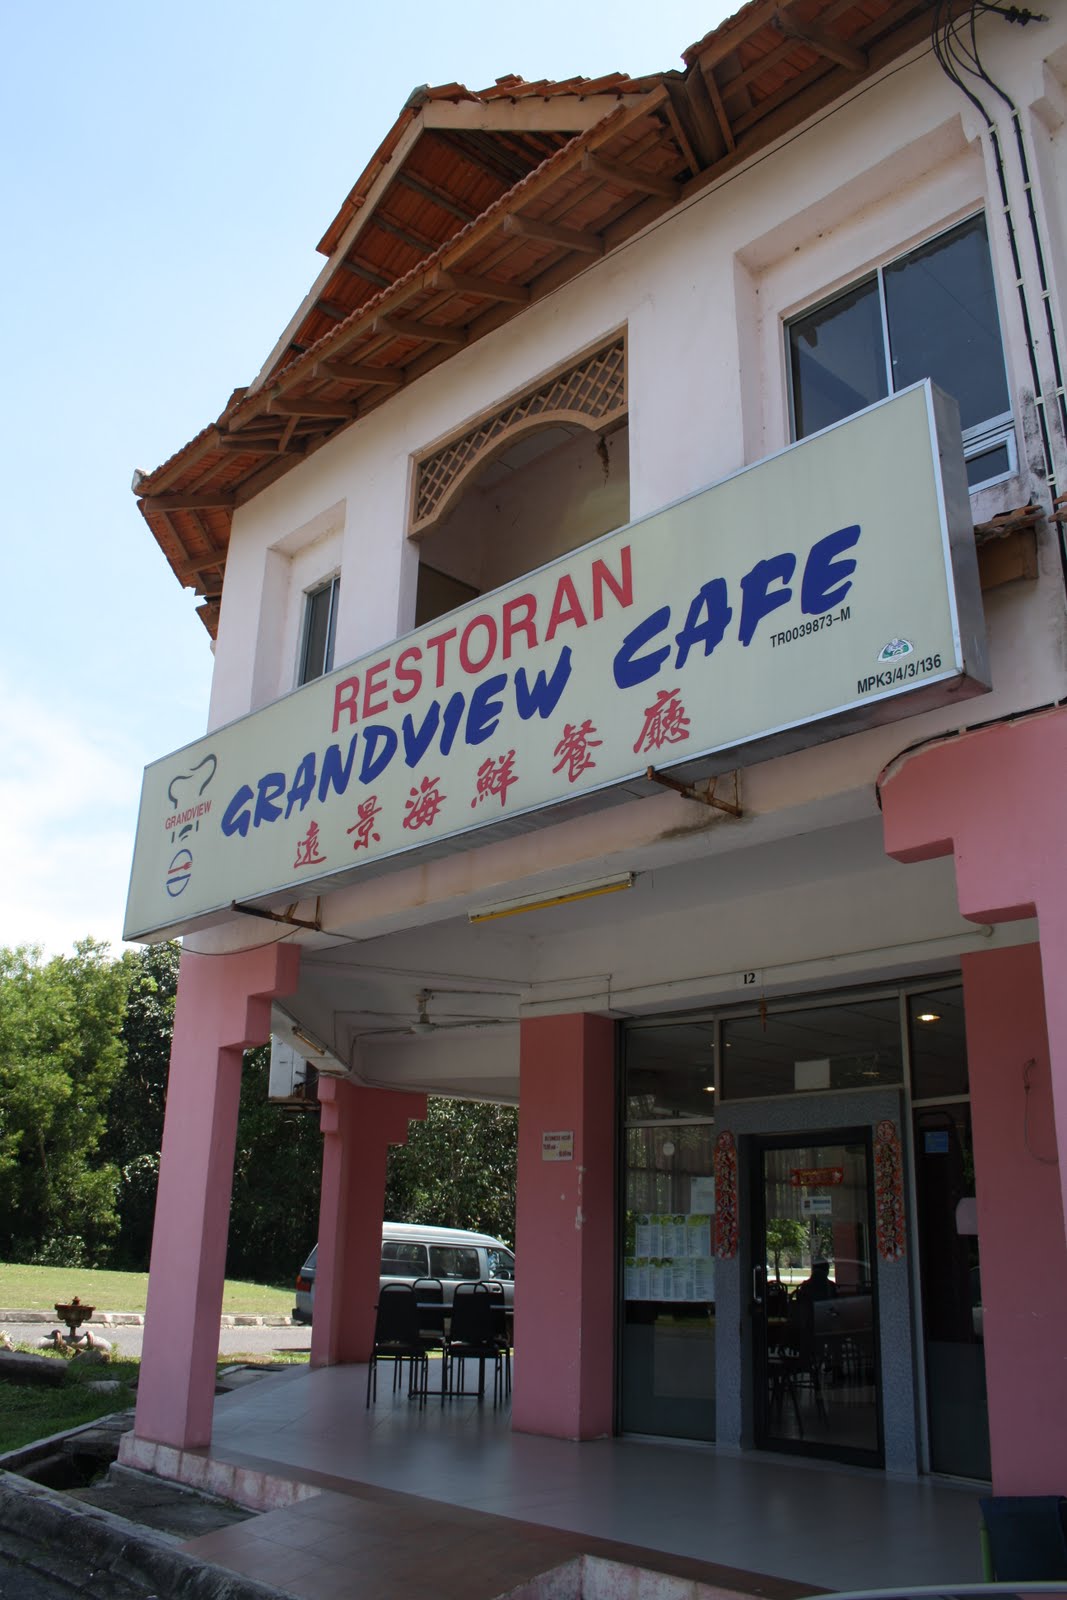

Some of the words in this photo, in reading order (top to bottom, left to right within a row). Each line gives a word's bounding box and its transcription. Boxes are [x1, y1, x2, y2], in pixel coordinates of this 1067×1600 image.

[332, 545, 633, 733] RESTORAN
[769, 606, 852, 648] TR0039873-M
[221, 646, 573, 838] GRANDVIEW
[612, 524, 862, 690] CAFE
[857, 653, 942, 694] MPK3/4/3/136
[165, 799, 213, 830] GRANDVIEW
[743, 972, 756, 985] 12
